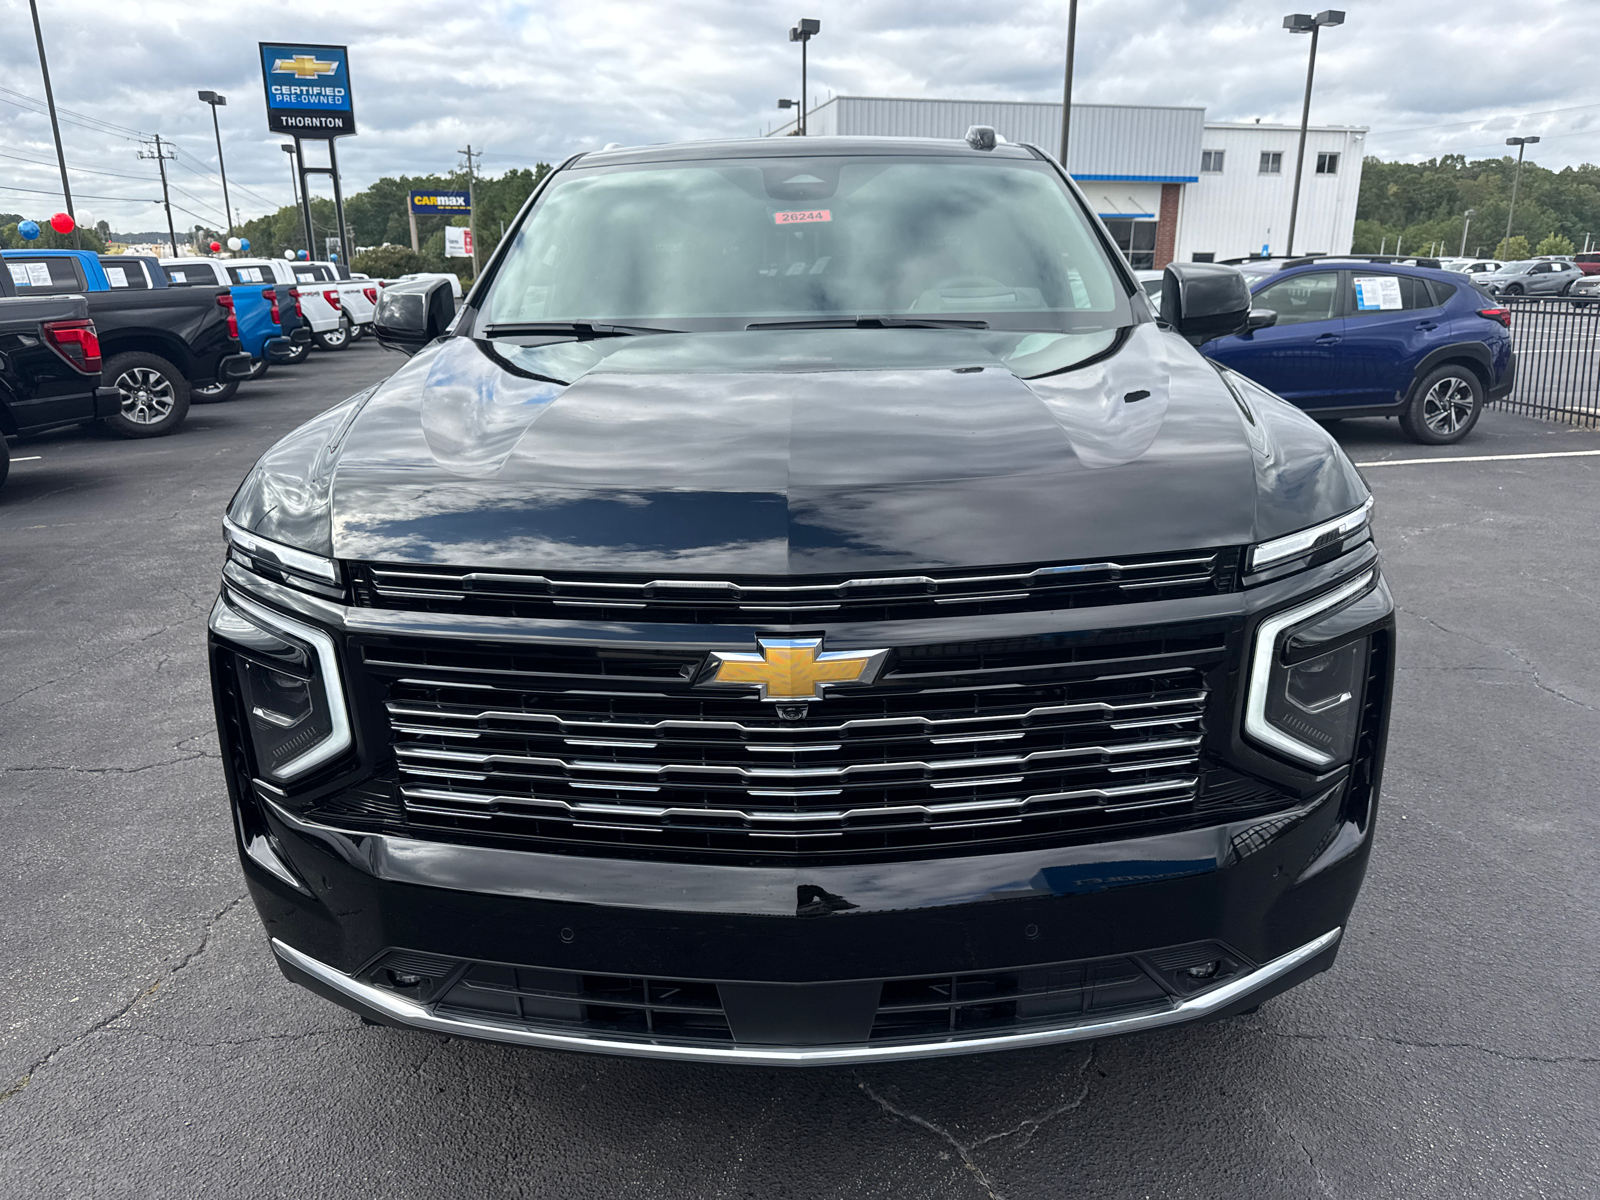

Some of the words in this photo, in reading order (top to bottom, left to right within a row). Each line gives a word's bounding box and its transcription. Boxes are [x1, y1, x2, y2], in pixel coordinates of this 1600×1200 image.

[271, 86, 345, 96] CERTIFIED
[276, 95, 342, 104] PRE-OWNED
[281, 117, 343, 127] THORNTON
[782, 212, 823, 222] 26244
